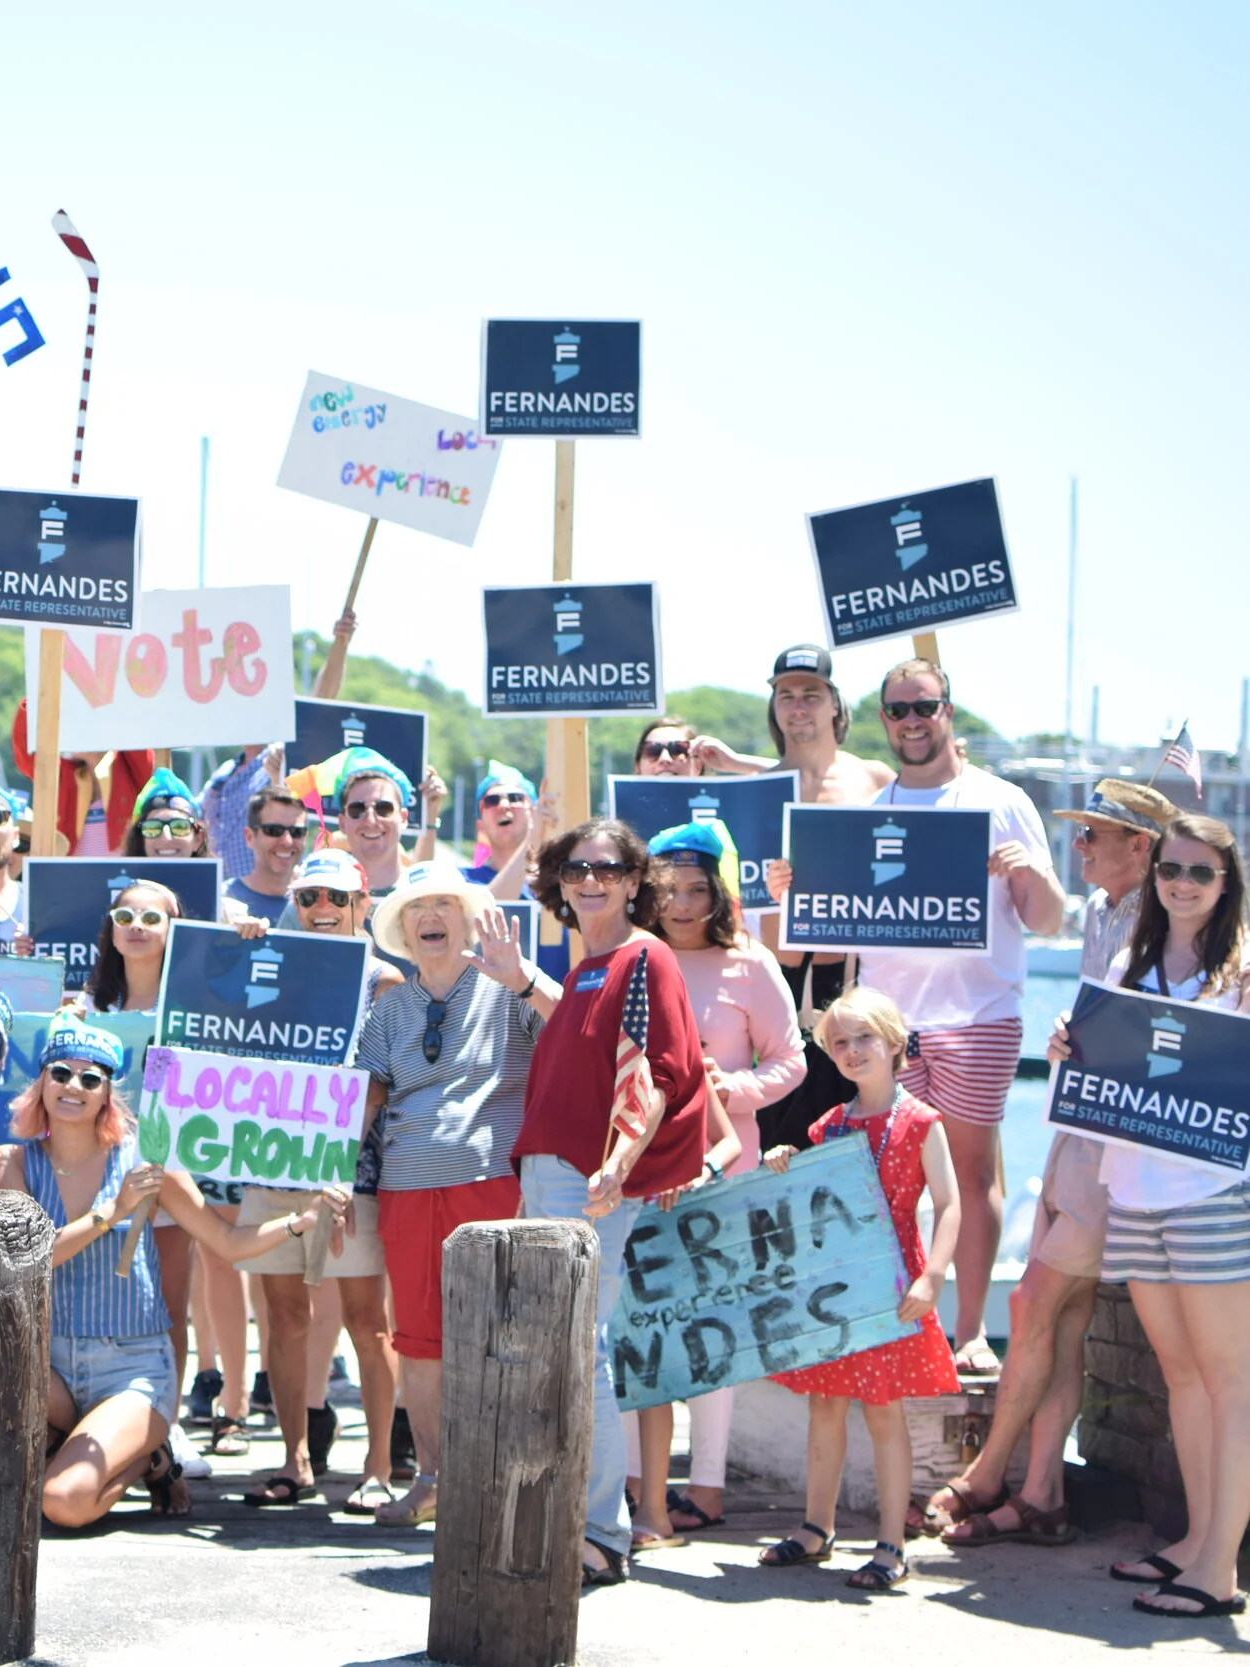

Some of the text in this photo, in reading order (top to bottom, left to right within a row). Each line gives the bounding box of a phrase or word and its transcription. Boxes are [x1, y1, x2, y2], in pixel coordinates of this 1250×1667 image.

[556, 345, 578, 362] F
[309, 385, 354, 412] new
[490, 391, 635, 413] FERNANDES
[312, 403, 387, 433] energy
[505, 416, 539, 428] STATE
[541, 417, 634, 428] REPRESENTATIVE
[340, 461, 471, 506] experience
[41, 520, 64, 540] F
[895, 521, 922, 546] F
[831, 559, 1006, 619] FERNANDES
[24, 600, 127, 620] REPRESENTATIVE
[556, 612, 581, 633] F
[855, 613, 894, 633] STATE
[897, 587, 1009, 623] REPRESENTATIVE
[492, 662, 651, 689] FERNANDES
[508, 692, 543, 704] STATE
[545, 690, 650, 704] REPRESENTATIVE
[343, 729, 365, 747] F
[875, 838, 904, 859] F
[793, 893, 982, 922] FERNANDES
[812, 923, 853, 937] STATE
[857, 924, 980, 940] REPRESENTATIVE
[250, 961, 279, 983] F
[167, 1009, 347, 1052] FERNANDES
[1153, 1028, 1183, 1051] F
[164, 1058, 360, 1128] LOCALLY
[1061, 1069, 1250, 1140] FERNANDES
[1058, 1100, 1243, 1159] FOR STATE REPRESENTATIVE
[176, 1114, 360, 1184] GROWN
